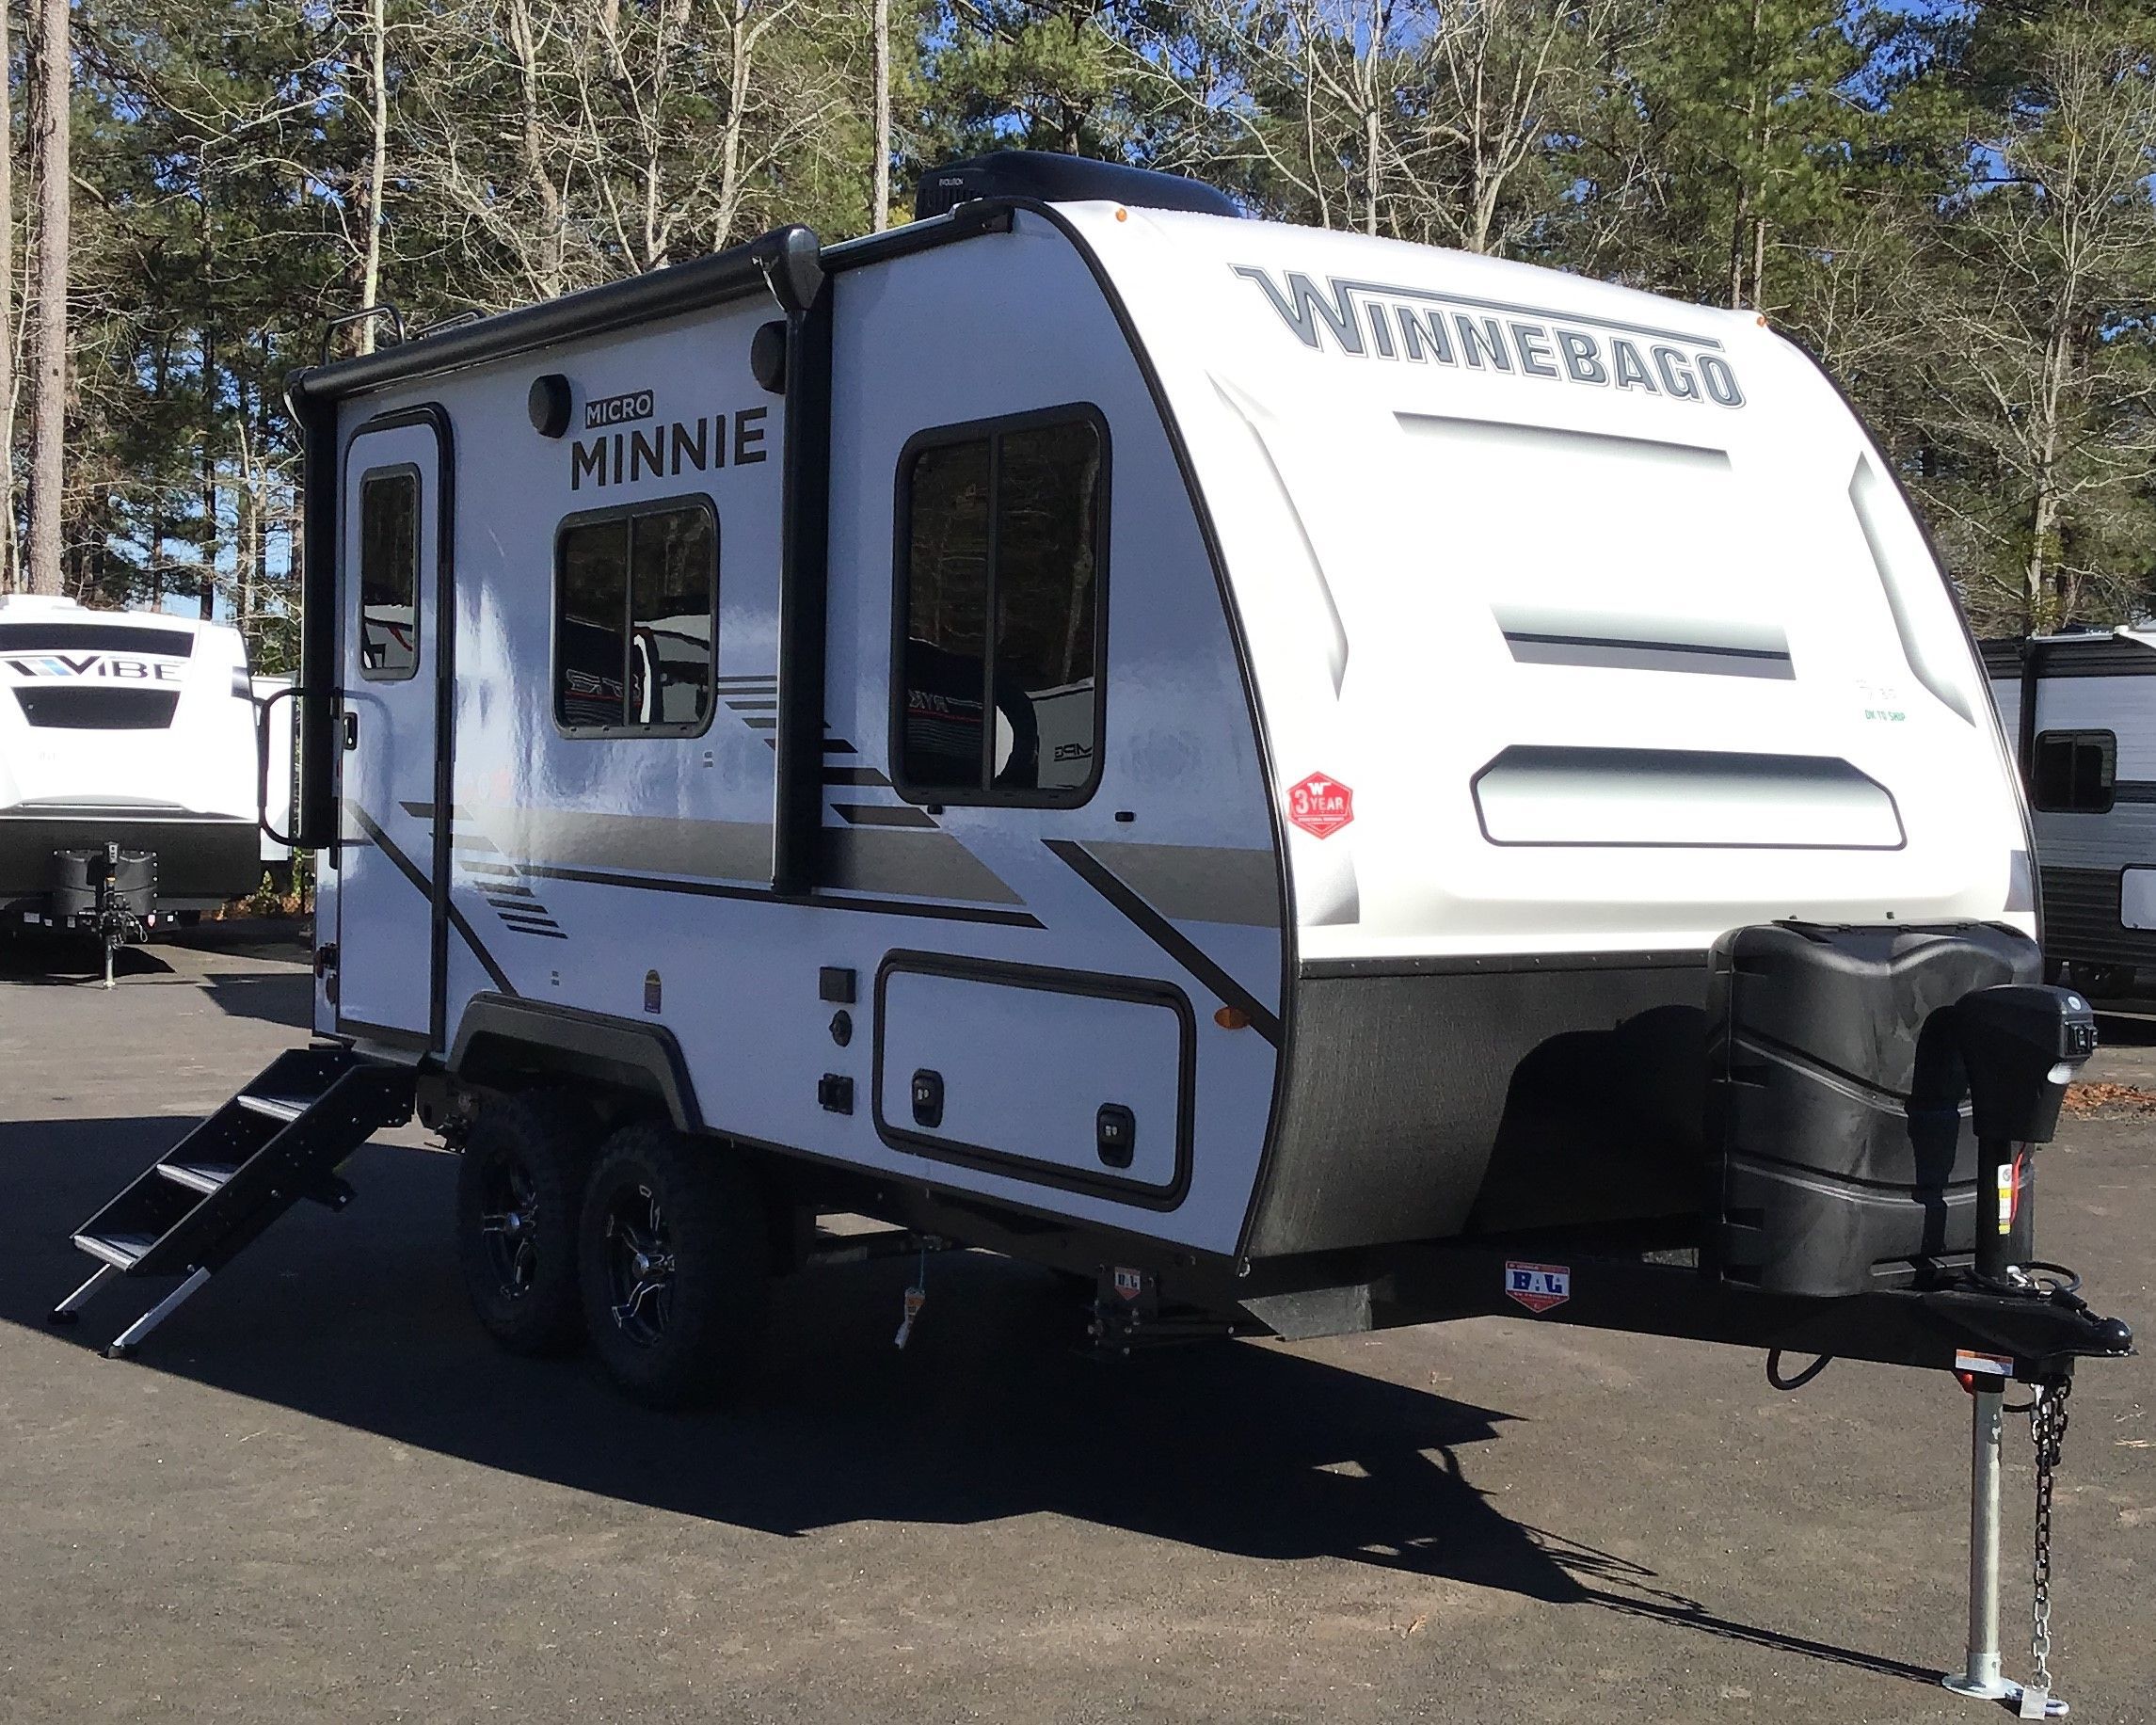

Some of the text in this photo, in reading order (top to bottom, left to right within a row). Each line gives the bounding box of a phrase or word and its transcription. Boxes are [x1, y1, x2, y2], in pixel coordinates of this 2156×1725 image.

[1228, 264, 1746, 408] WINNEBAGO
[586, 393, 652, 425] MICRO
[571, 407, 768, 490] MINNIE
[55, 655, 184, 682] VIBE
[1294, 789, 1345, 814] 3 YEAR
